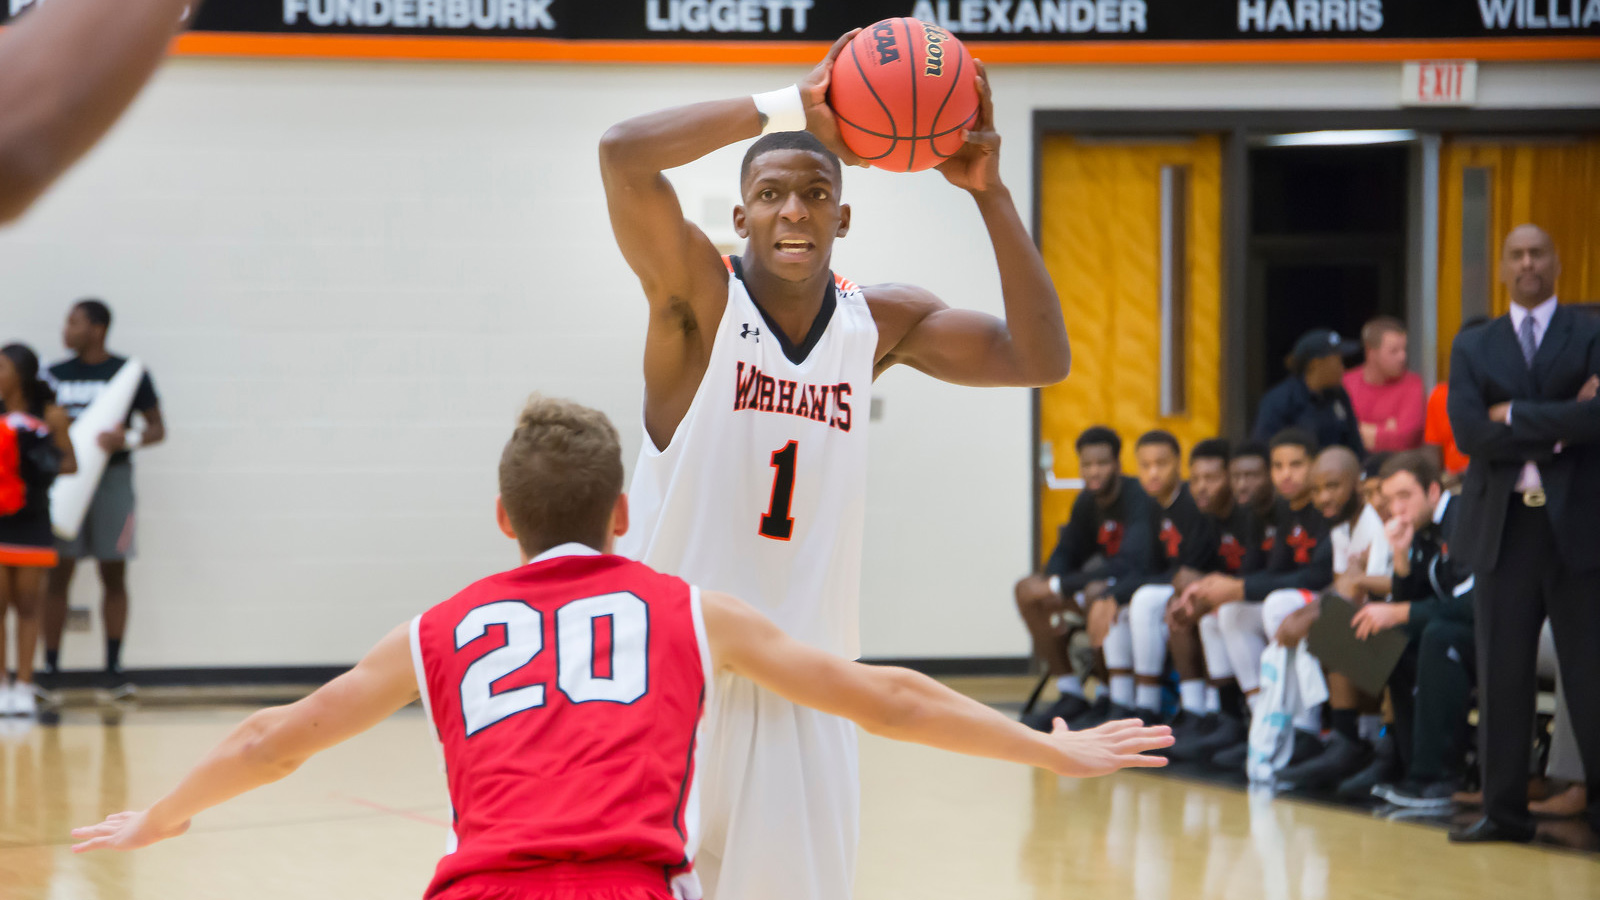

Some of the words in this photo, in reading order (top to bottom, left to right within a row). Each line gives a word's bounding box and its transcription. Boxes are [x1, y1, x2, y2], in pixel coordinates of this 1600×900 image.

[283, 0, 555, 29] FUNDERBURK
[646, 0, 813, 32] LIGGETT
[912, 0, 1148, 33] ALEXANDER
[1238, 0, 1384, 31] HARRIS
[1418, 61, 1465, 102] EXIT
[758, 439, 798, 541] 1
[454, 591, 648, 740] 20
